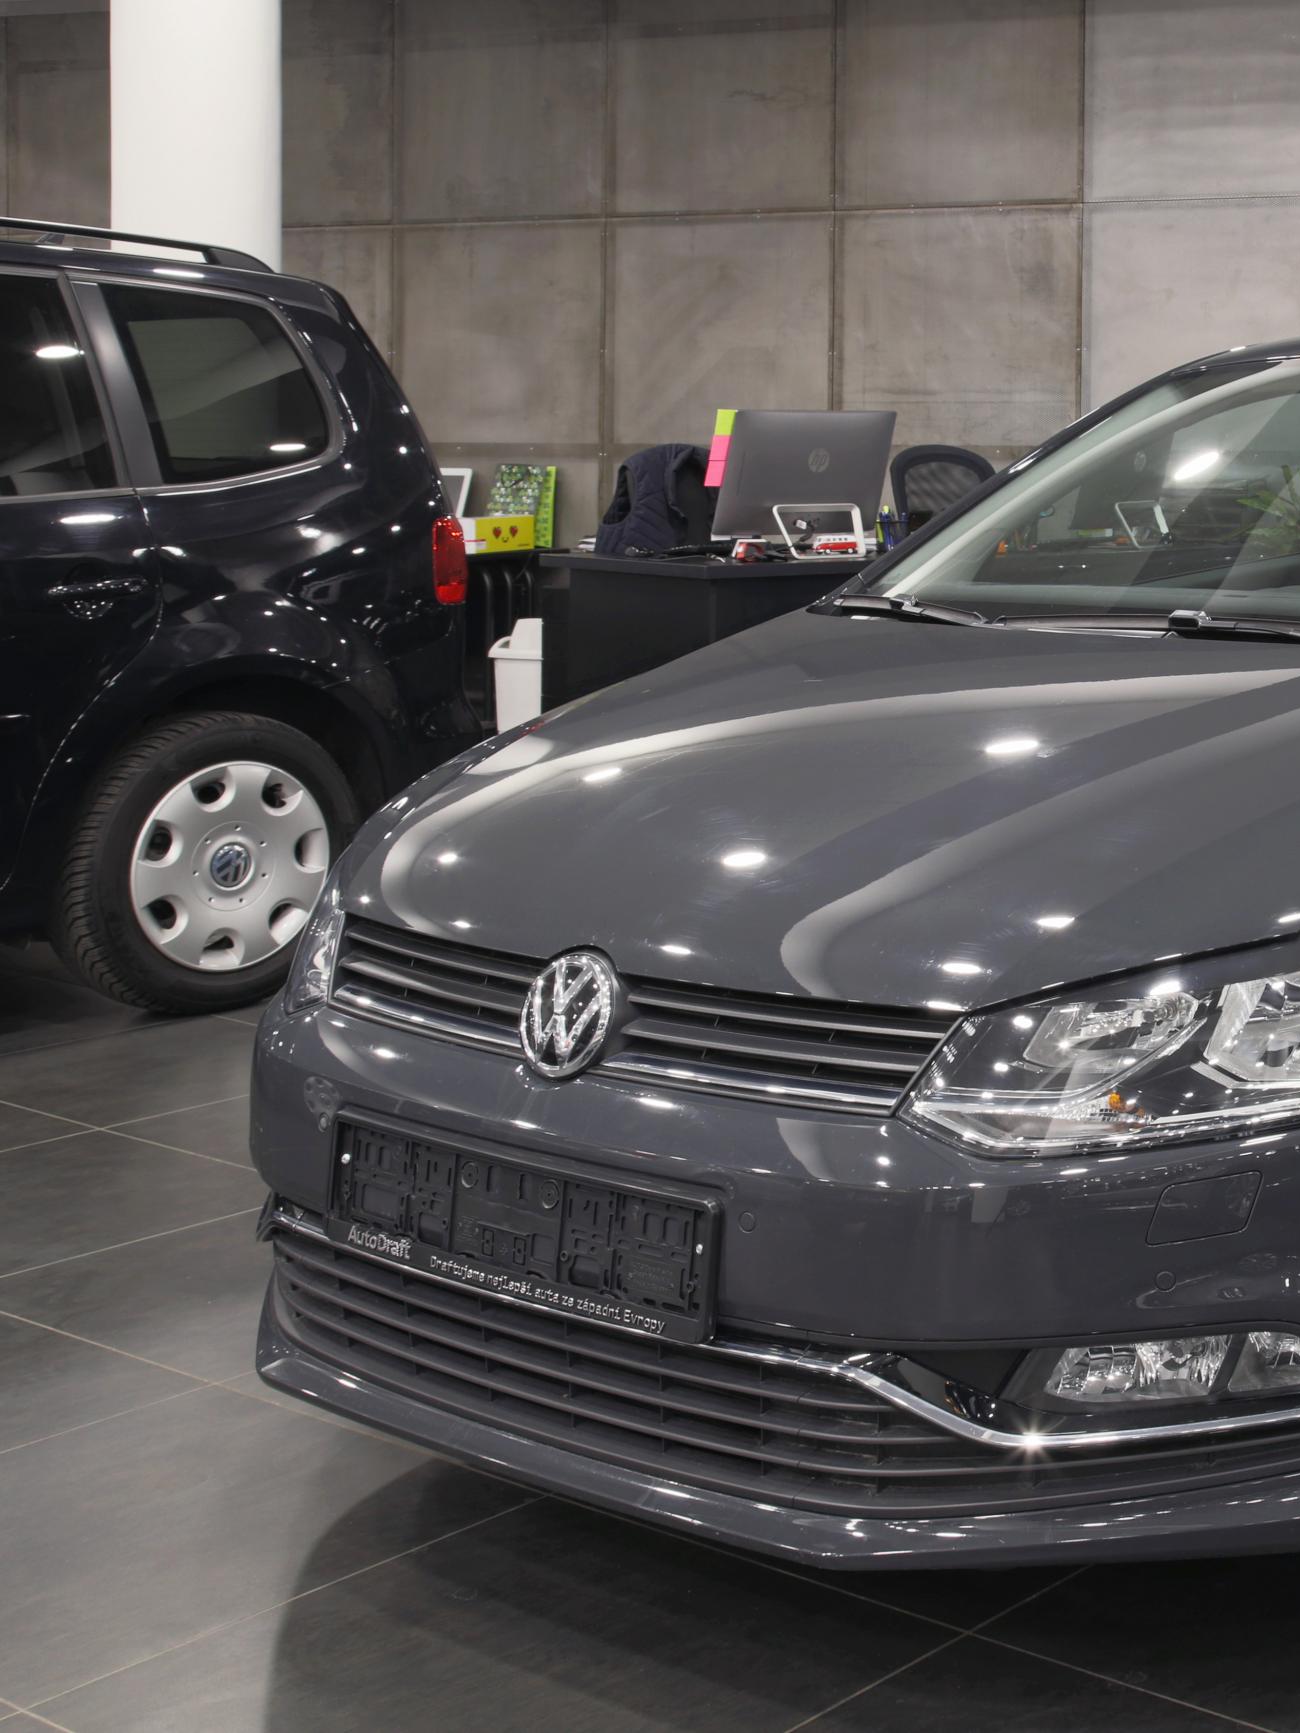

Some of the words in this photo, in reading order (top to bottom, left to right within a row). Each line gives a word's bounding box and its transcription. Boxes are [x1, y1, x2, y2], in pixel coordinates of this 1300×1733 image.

[808, 449, 830, 472] hp
[522, 954, 612, 1075] VW
[347, 1225, 411, 1260] AutoDraft
[430, 1255, 485, 1282] Draftujeme
[535, 1288, 559, 1304] auta
[562, 1295, 574, 1307] ze
[577, 1298, 621, 1318] západní
[623, 1308, 665, 1334] Evropy
